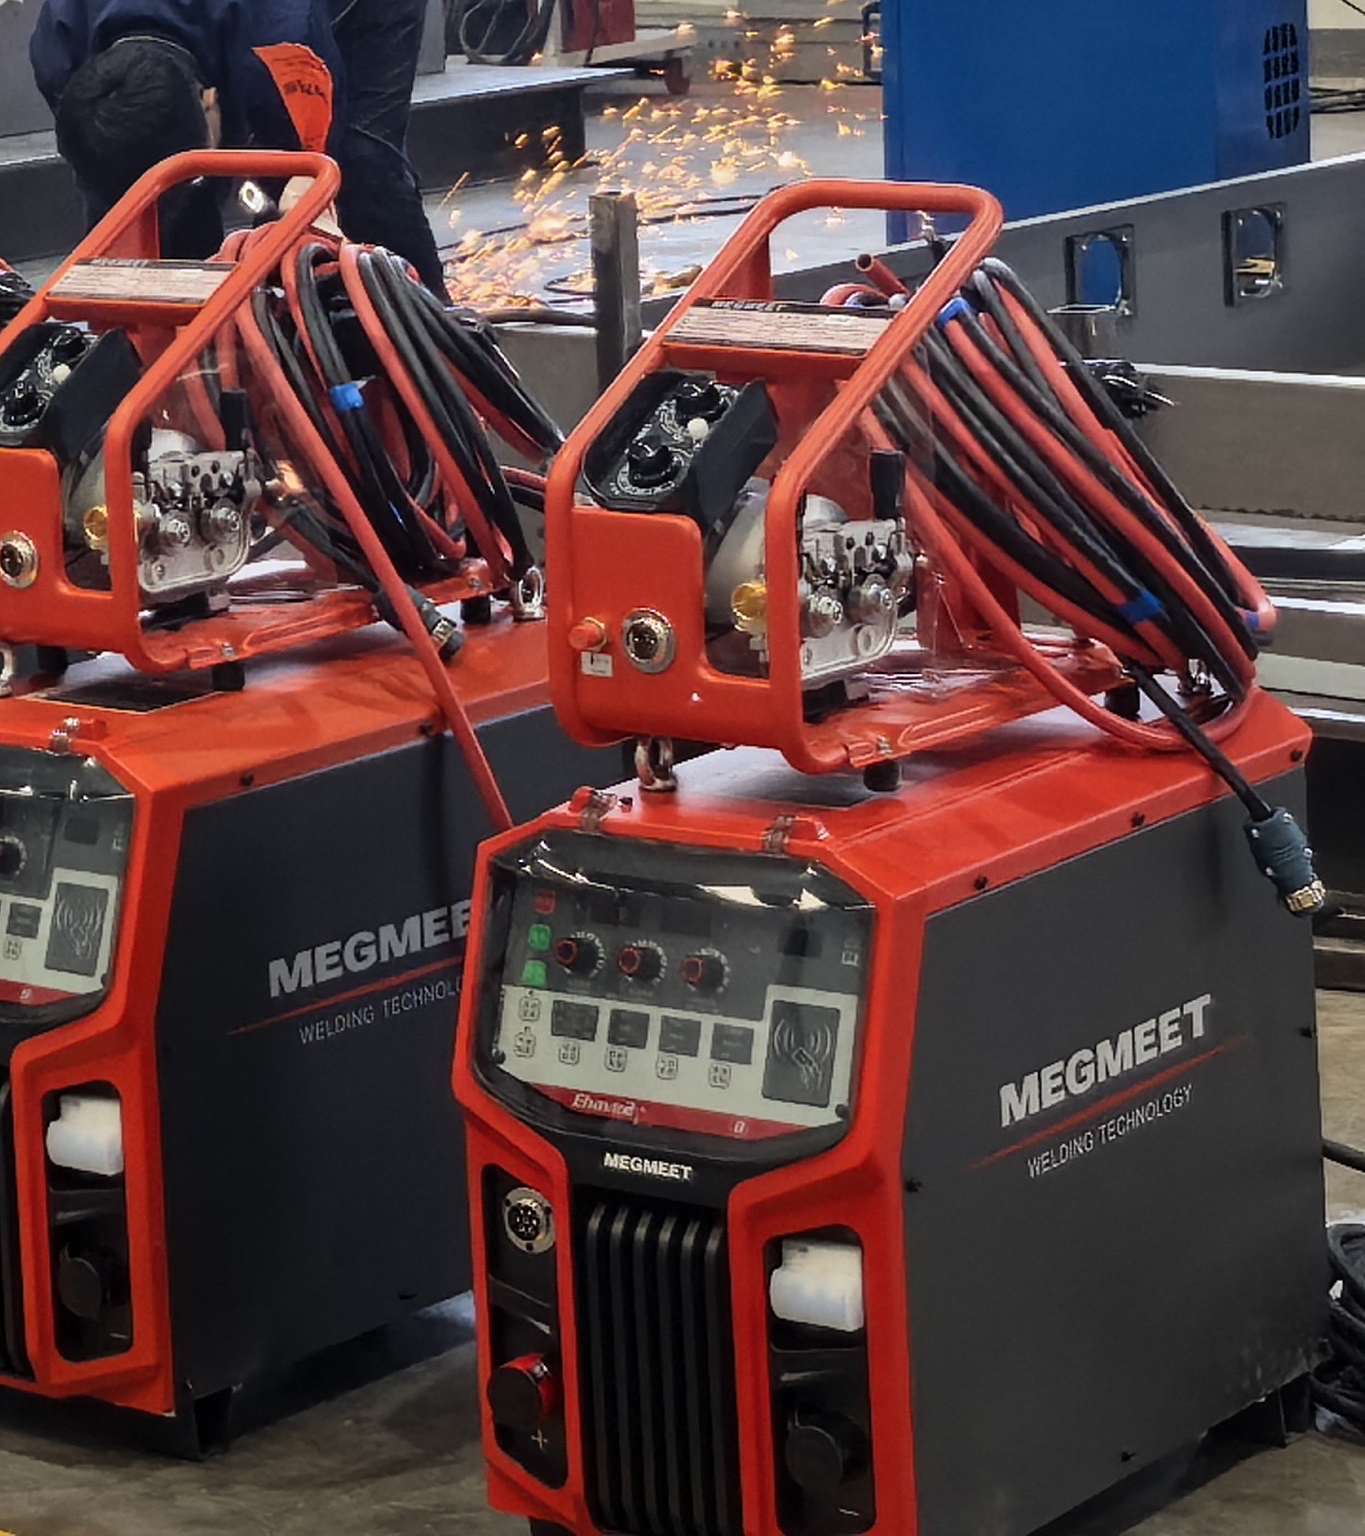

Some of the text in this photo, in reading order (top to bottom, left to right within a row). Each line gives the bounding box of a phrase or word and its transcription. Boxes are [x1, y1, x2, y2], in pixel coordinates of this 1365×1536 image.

[299, 1005, 375, 1044] WELDING
[999, 993, 1211, 1128] MEGMEET
[1027, 1084, 1192, 1179] WELDING TECHNOLOGY
[603, 1152, 693, 1181] MEGMEET
